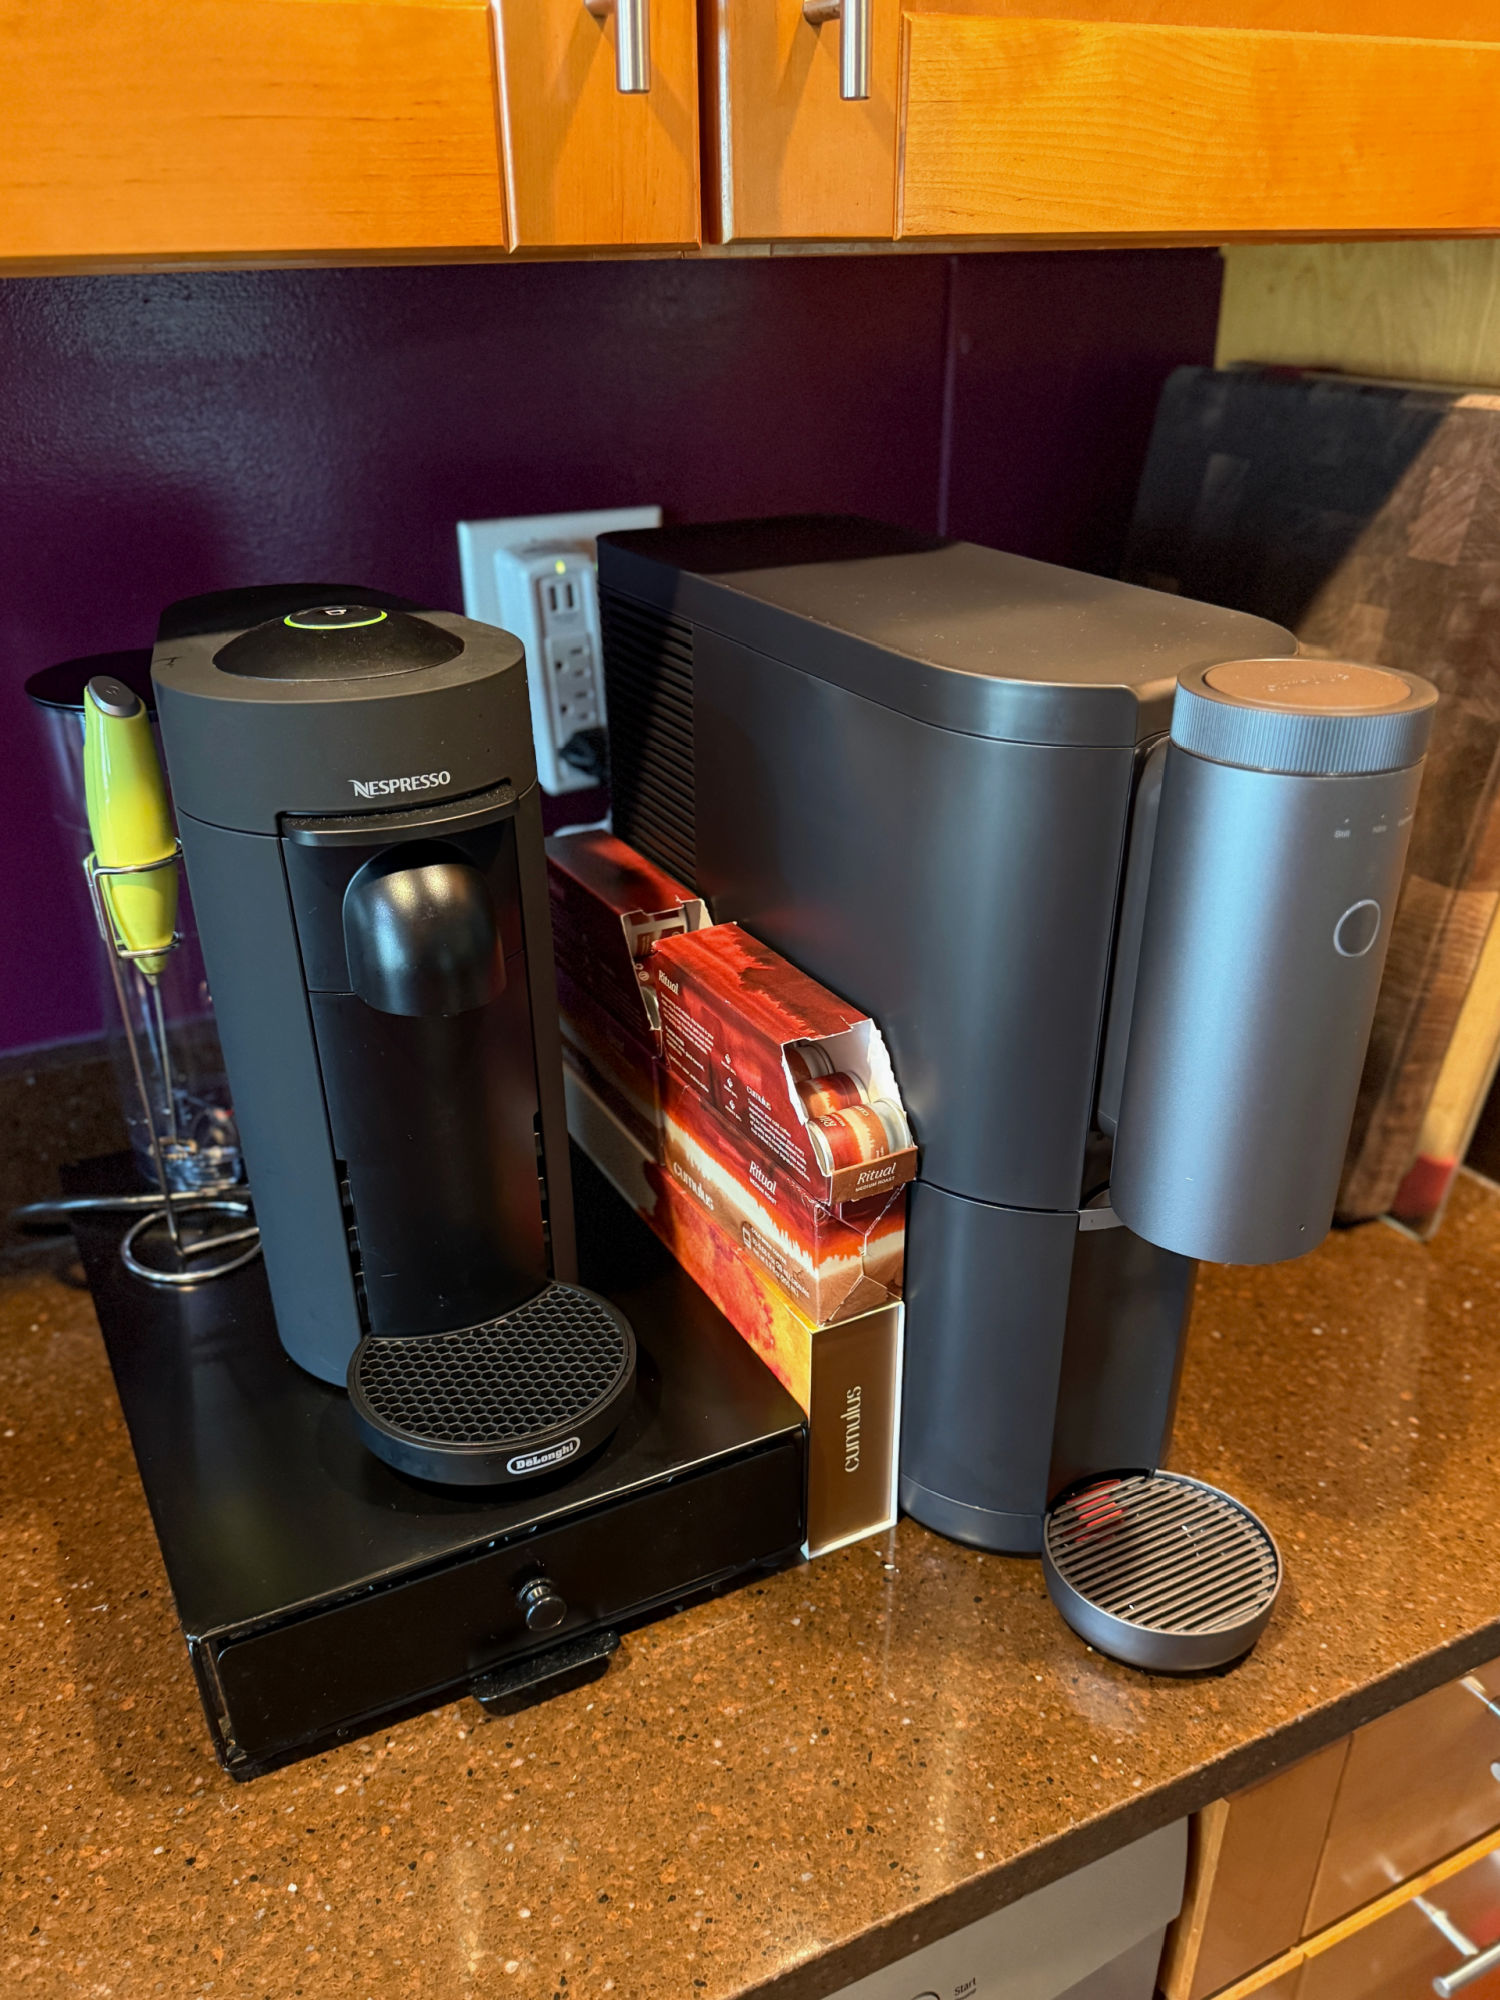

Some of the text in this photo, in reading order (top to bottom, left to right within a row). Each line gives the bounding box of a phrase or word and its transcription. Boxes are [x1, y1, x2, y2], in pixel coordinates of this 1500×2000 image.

[347, 770, 451, 799] NESPRESSO
[658, 969, 679, 995] Ritual
[749, 1160, 777, 1195] Ritual
[855, 1175, 895, 1192] MEDIUM ROAST
[856, 1162, 897, 1185] Ritual
[840, 1385, 862, 1473] cumulus
[954, 1976, 977, 1996] Start
